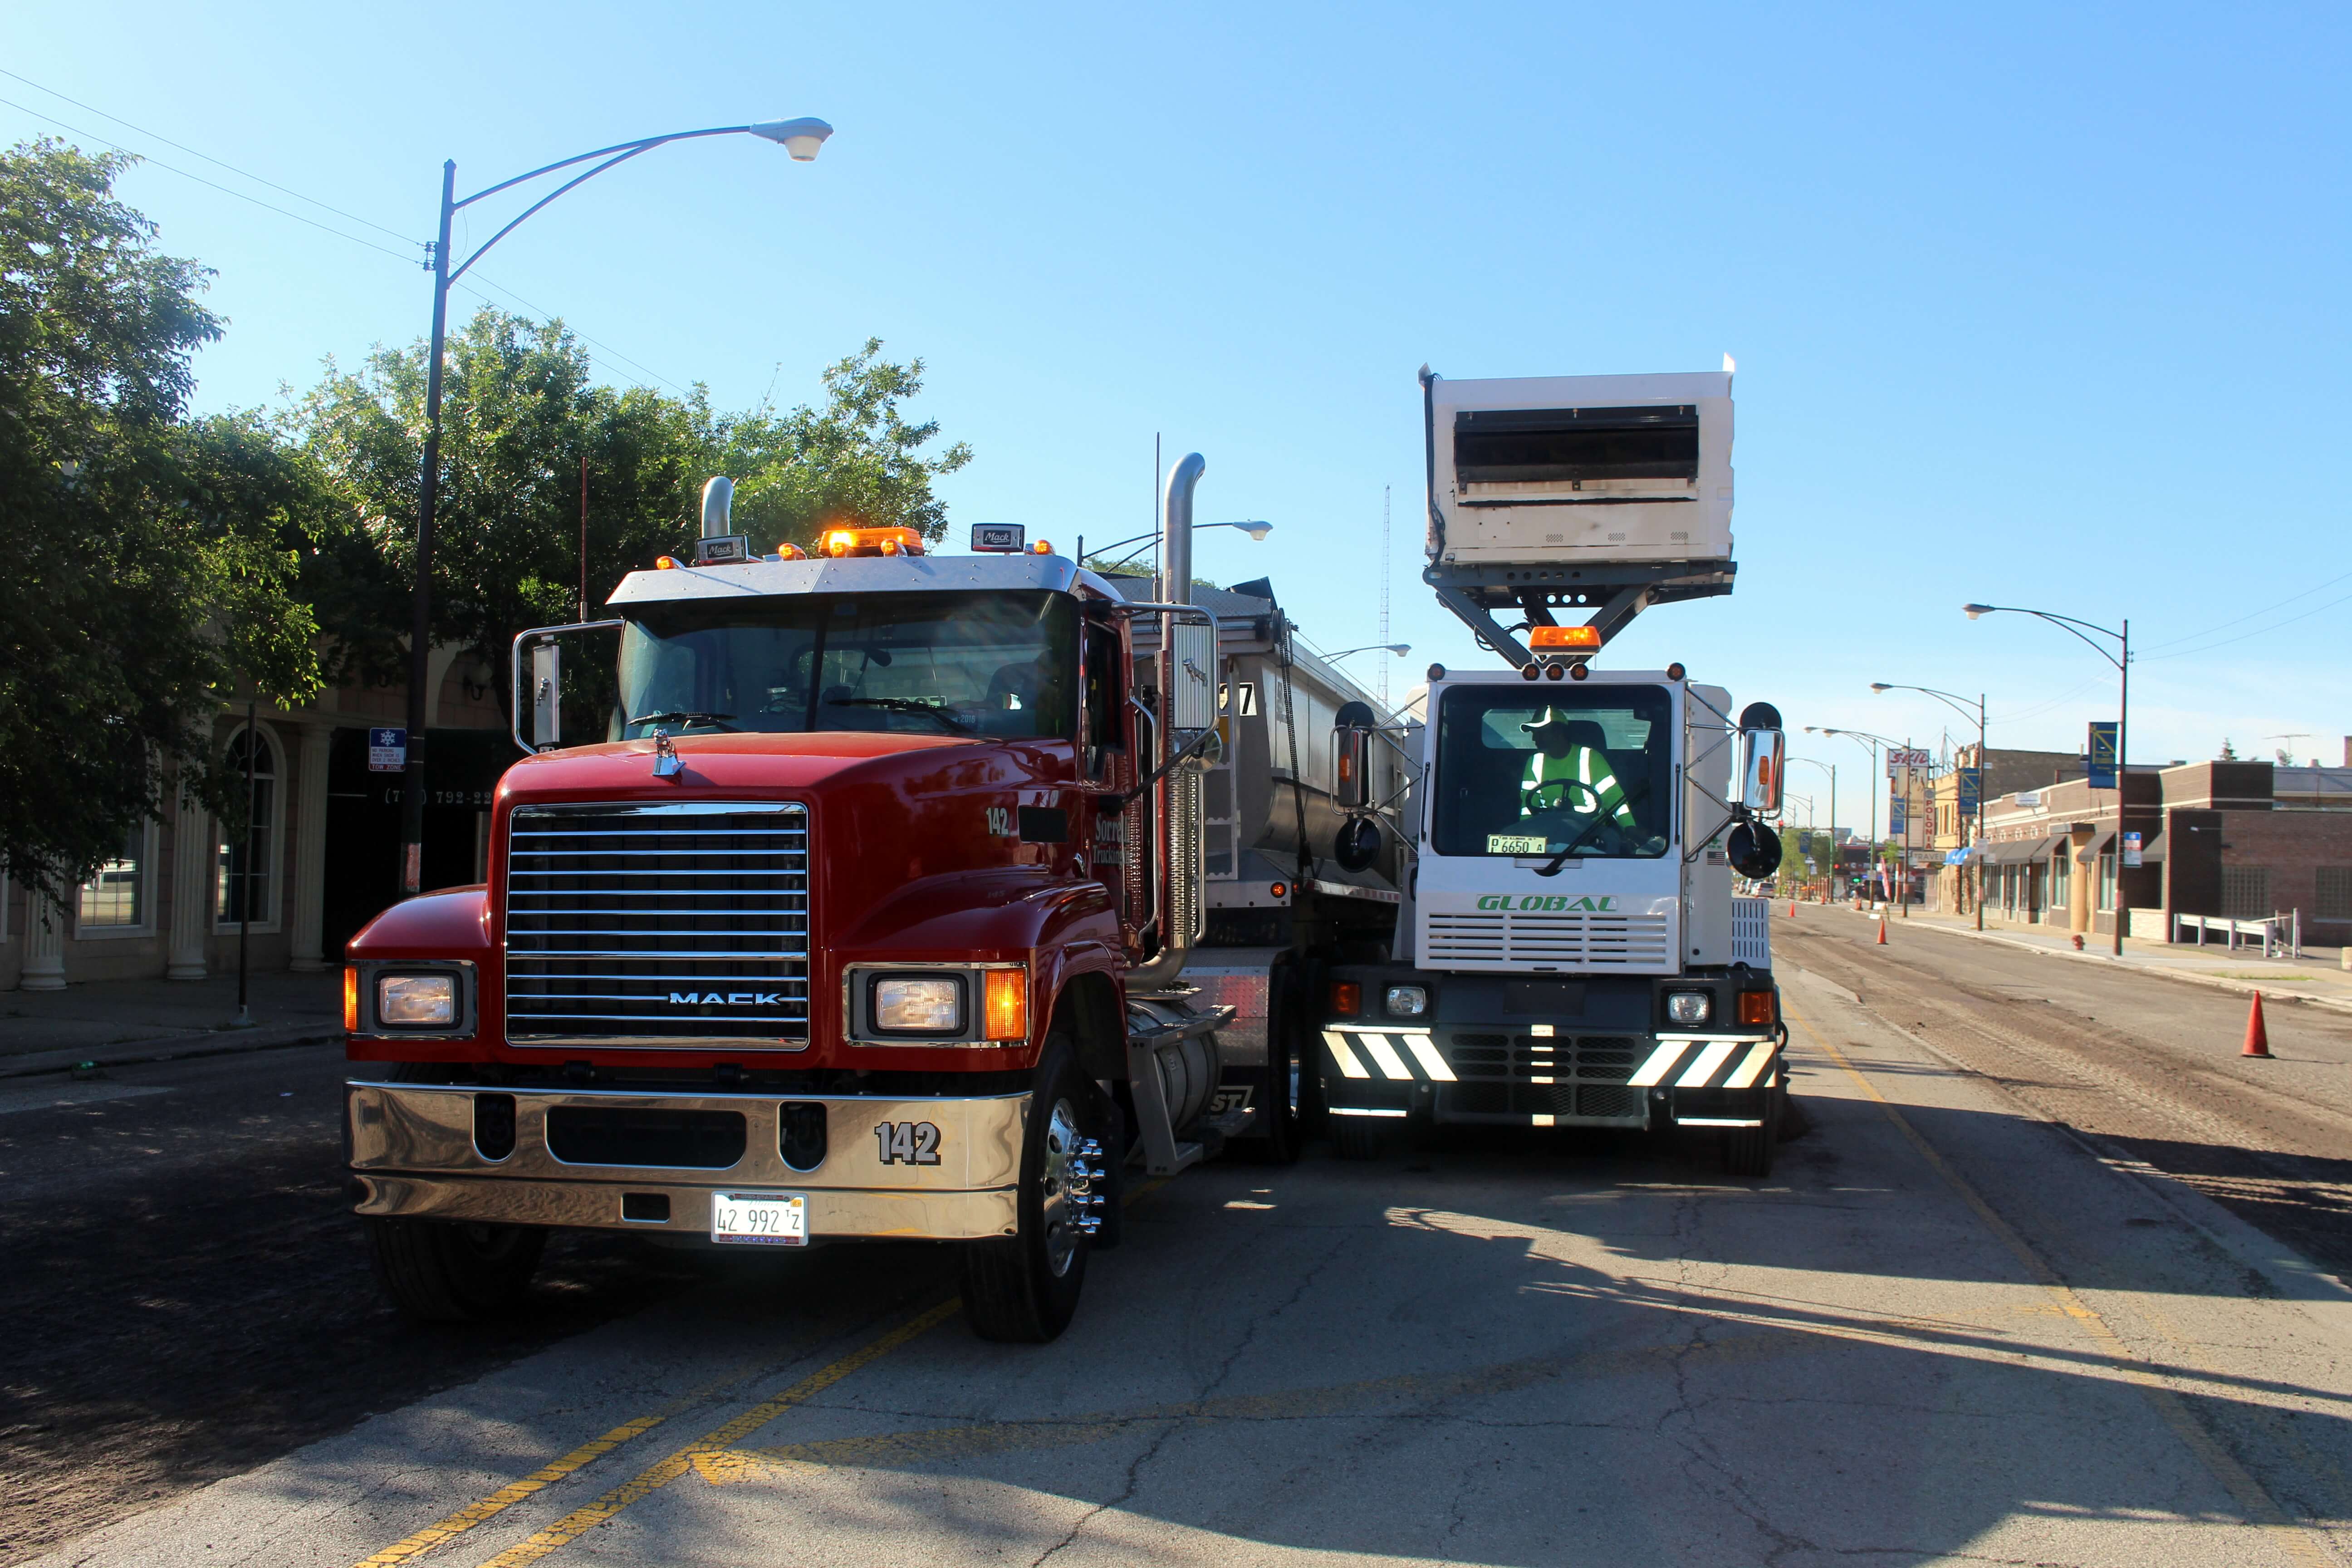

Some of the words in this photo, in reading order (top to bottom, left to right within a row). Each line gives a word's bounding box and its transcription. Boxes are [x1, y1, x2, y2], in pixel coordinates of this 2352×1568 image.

[984, 533, 1009, 543] Mack
[709, 544, 732, 555] Mack
[960, 715, 975, 724] 2016
[386, 788, 427, 805] (7)
[436, 791, 492, 804] 792-22
[986, 808, 1009, 835] 142
[1502, 841, 1529, 853] 6650
[1093, 845, 1123, 870] Trucking
[1477, 896, 1617, 911] GLOBAL
[670, 993, 780, 1005] MACK
[1210, 1094, 1242, 1111] ST
[874, 1122, 941, 1165] 142
[718, 1208, 737, 1231] 42
[749, 1210, 779, 1232] 992
[792, 1214, 800, 1230] Z
